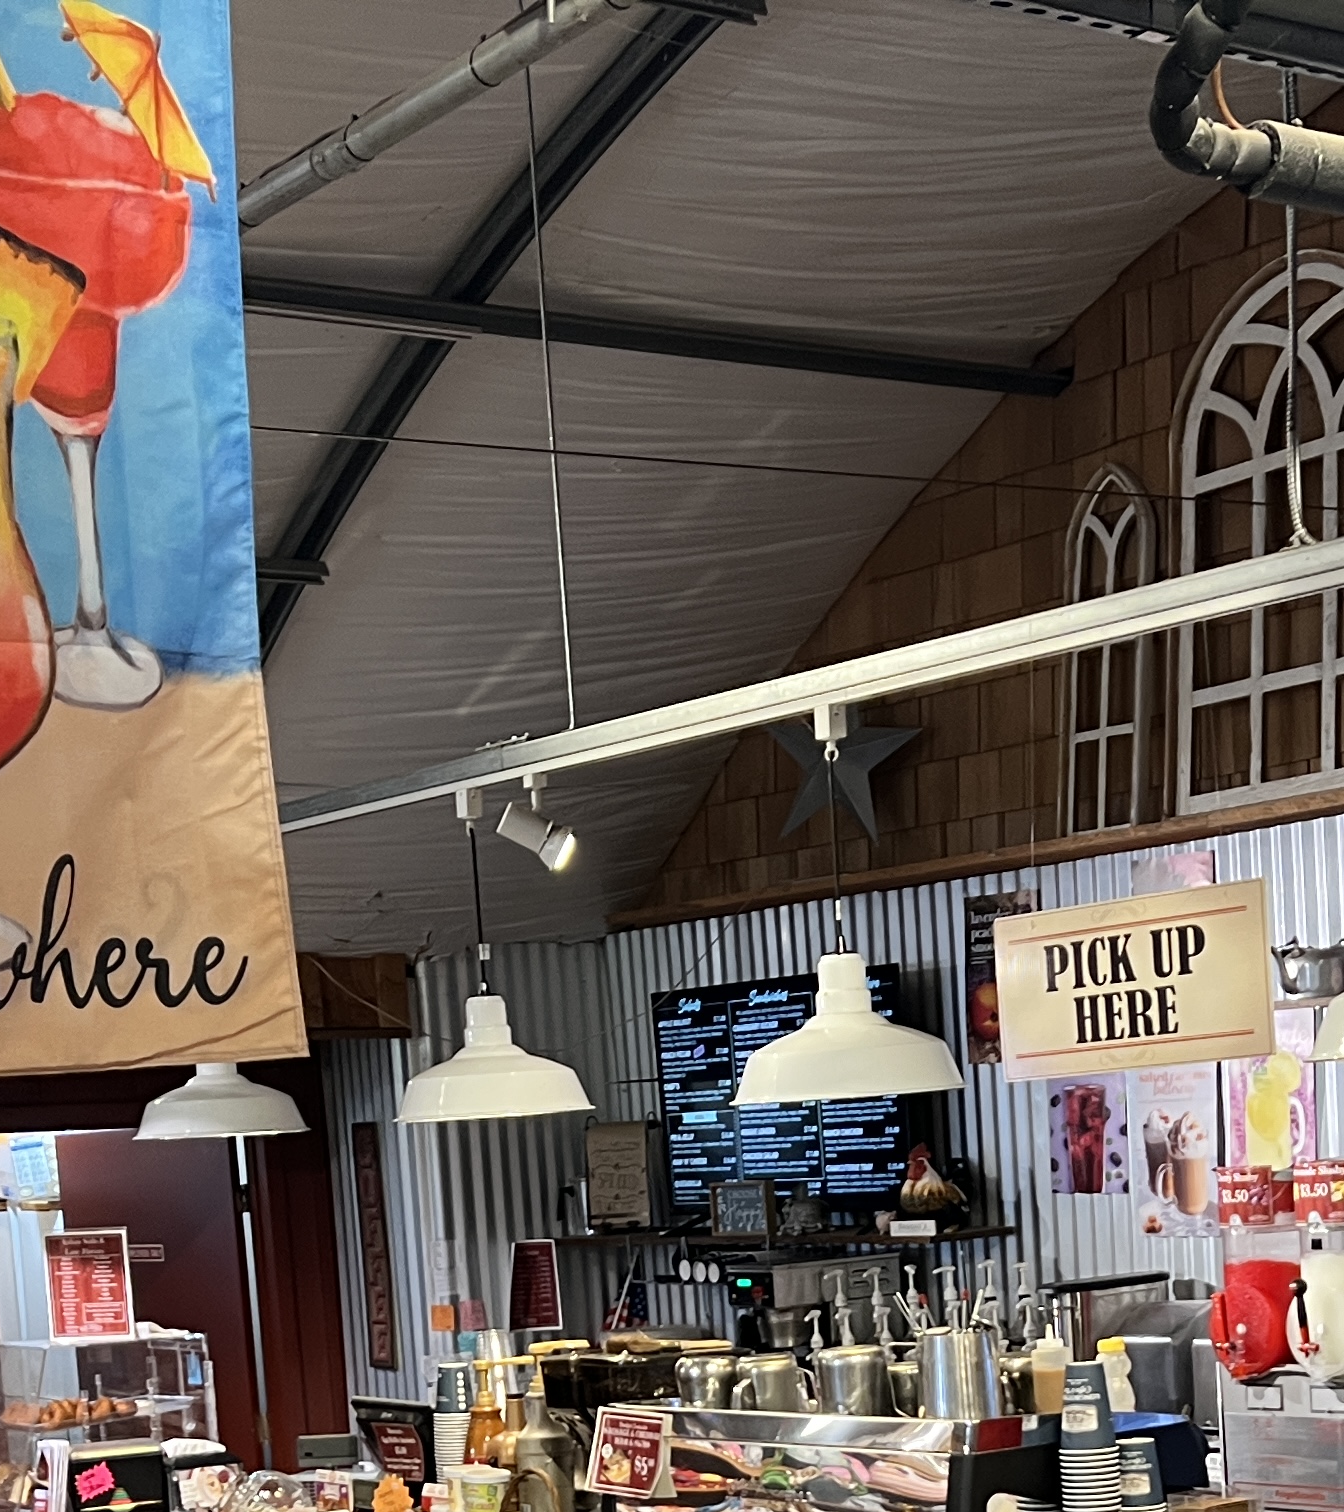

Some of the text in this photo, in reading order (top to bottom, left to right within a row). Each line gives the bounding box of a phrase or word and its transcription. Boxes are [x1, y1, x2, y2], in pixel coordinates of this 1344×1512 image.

[1043, 924, 1206, 993] PICK UP
[1073, 984, 1179, 1044] HERE
